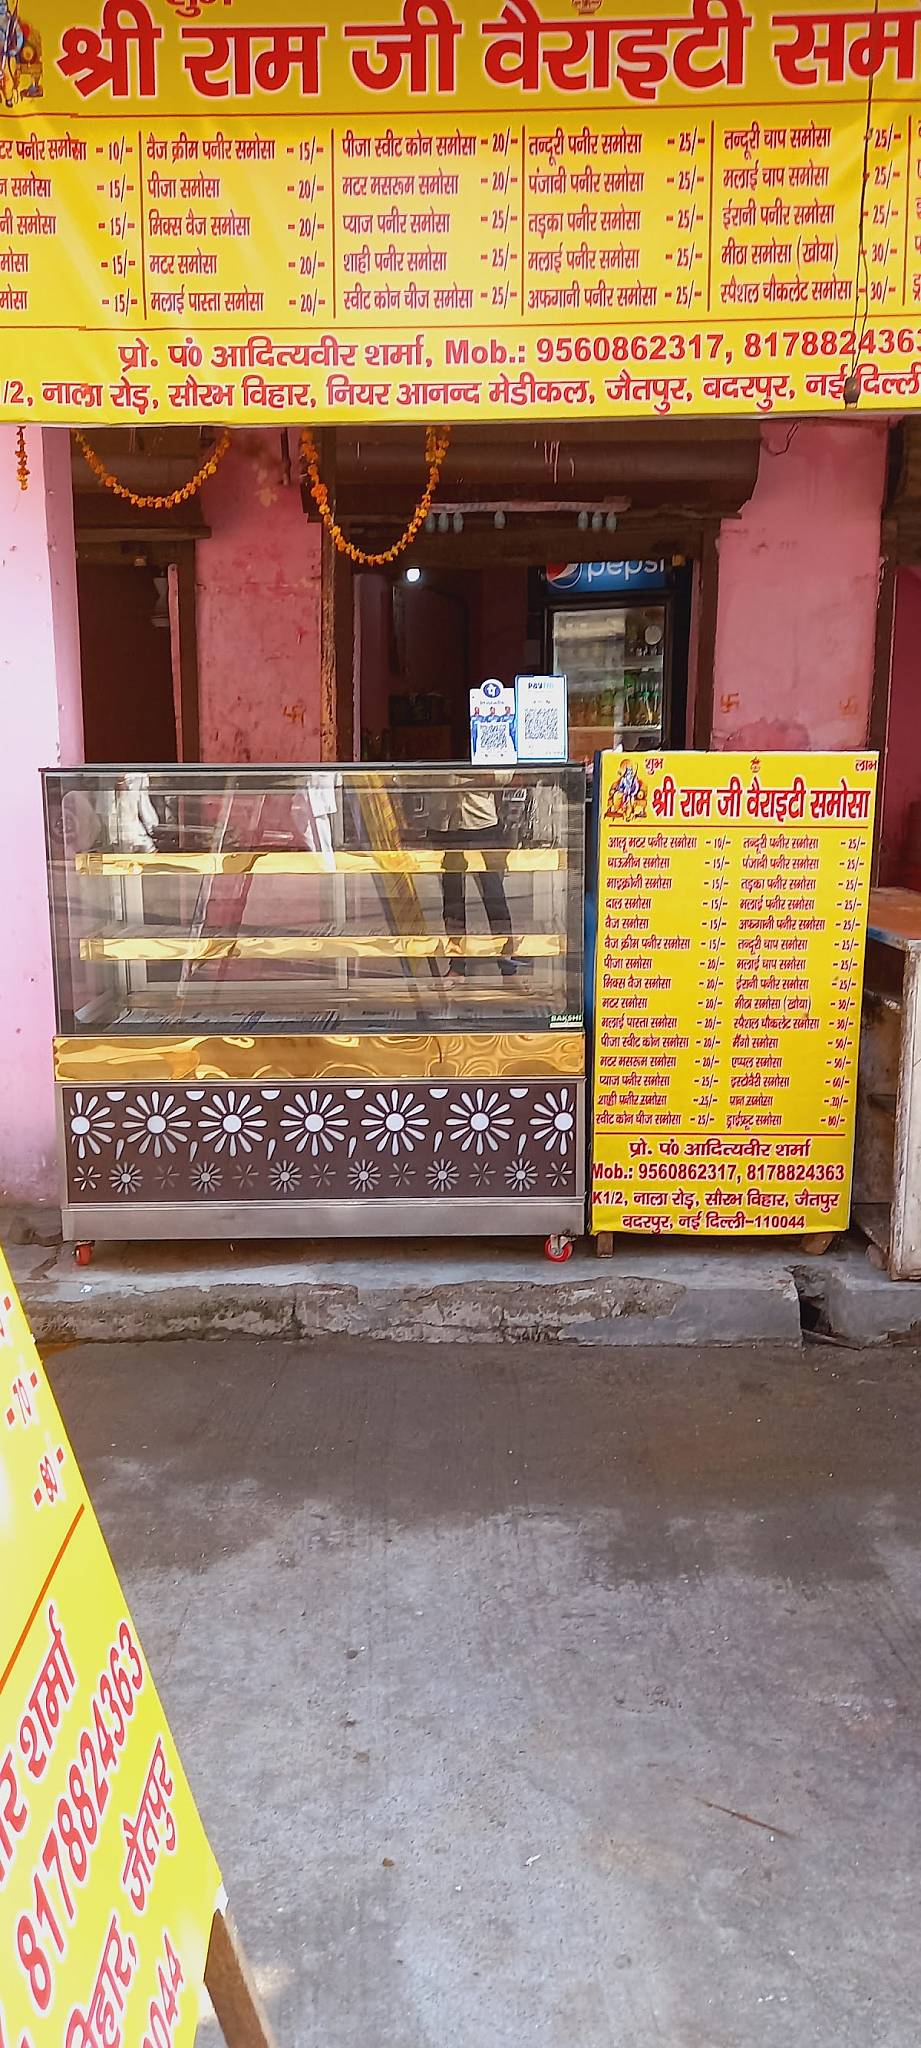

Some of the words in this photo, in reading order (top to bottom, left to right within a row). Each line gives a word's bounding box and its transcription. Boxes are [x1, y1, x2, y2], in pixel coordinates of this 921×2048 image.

[57, 0, 162, 98] श्री
[182, 25, 326, 98] राम
[344, 0, 462, 95] जी
[481, 0, 752, 99] वैराइटी
[16, 132, 45, 160] पनीर
[47, 132, 87, 160] समोसा
[146, 132, 168, 160] वैज
[171, 132, 199, 163] क्रीम
[202, 132, 233, 160] पनीर
[235, 132, 275, 160] समोसा
[342, 130, 371, 157] पीजा
[374, 129, 403, 157] स्वीट
[405, 129, 433, 156] कोन
[436, 128, 477, 156] समोसा
[529, 127, 565, 166] तन्दूरी
[568, 126, 599, 155] पनीर
[601, 126, 642, 155] समोसा
[724, 121, 760, 160] तन्दूरी
[764, 129, 787, 149] चाप
[790, 120, 831, 148] समोसा
[11, 170, 51, 197] समोसा
[147, 170, 176, 198] पीजा
[180, 170, 220, 198] समोसा
[343, 177, 368, 196] मटर
[370, 176, 415, 195] मसरूम
[418, 167, 459, 195] समोसा
[570, 165, 601, 192] पनीर
[604, 165, 644, 192] समोसा
[723, 160, 759, 191] मलाई
[762, 168, 785, 187] चाप
[789, 159, 829, 187] समोसा
[16, 208, 56, 235] समोसा
[148, 209, 182, 236] मिक्स
[186, 208, 207, 236] वैज
[210, 209, 250, 236] समोसा
[343, 215, 373, 234] प्याज
[377, 206, 407, 233] पनीर
[410, 206, 450, 233] समोसा
[528, 213, 563, 239] तड़का
[567, 204, 598, 231] पनीर
[600, 203, 641, 231] समोसा
[723, 198, 757, 230] ईरानी
[760, 197, 791, 226] पनीर
[794, 198, 835, 225] समोसा
[149, 255, 175, 274] मटर
[178, 247, 217, 274] समोसा
[344, 245, 370, 274] शाही
[374, 244, 404, 271] पनीर
[407, 245, 447, 271] समोसा
[528, 242, 563, 273] मलाई
[566, 242, 596, 269] पनीर
[599, 242, 640, 269] समोसा
[722, 237, 748, 265] मीठा
[751, 237, 792, 264] समोसा
[797, 235, 838, 269] (खोया)
[150, 284, 185, 314] मलाई
[188, 293, 221, 311] पास्ता
[224, 285, 264, 311] समोसा
[344, 282, 371, 309] स्वीट
[374, 283, 401, 309] कोन
[404, 282, 429, 309] चीज
[434, 282, 473, 309] समोसा
[528, 280, 580, 309] अफगानी
[584, 280, 614, 307] पनीर
[617, 280, 657, 307] समोसा
[812, 273, 852, 301] समोसा
[118, 338, 158, 372] प्रो.
[211, 335, 358, 367] आदित्यवीर
[365, 335, 432, 367] शर्मा,
[446, 339, 525, 364] Mob.:
[537, 334, 732, 364] 9560862317,
[42, 383, 103, 407] नाला
[110, 376, 158, 415] रोड़,
[168, 374, 235, 407] सौरभ
[241, 375, 316, 408] विहार,
[326, 374, 391, 405] नियर
[396, 383, 482, 405] आनन्द
[489, 372, 595, 405] मेडीकल,
[603, 369, 696, 418] जैतपुर,
[701, 376, 798, 415] बदरपुर,
[806, 364, 848, 402] नई
[645, 758, 663, 775] शुभ
[855, 760, 877, 771] लाभ
[652, 776, 676, 816] श्री
[680, 789, 712, 817] राम
[717, 776, 743, 817] जी
[747, 776, 806, 822] वैराइटी
[810, 778, 871, 818] समोसा
[608, 837, 628, 853] आलू
[628, 837, 646, 848] मटर
[648, 833, 668, 848] पनीर
[670, 836, 697, 848] समोसा
[643, 854, 670, 868] समोसा
[606, 898, 623, 909] दाल
[624, 895, 651, 909] समोसा
[605, 914, 620, 928] वैज
[622, 914, 649, 929] समोसा
[604, 954, 623, 969] पीजा
[625, 955, 652, 969] समोसा
[602, 998, 619, 1008] मटर
[621, 994, 647, 1008] समोसा
[752, 1034, 778, 1048] समोसा
[629, 1138, 652, 1158] प्रो.
[684, 1138, 772, 1156] आदित्यवीर
[775, 1139, 811, 1156] शर्मा
[592, 1163, 633, 1181] Mob.:
[639, 1163, 741, 1184] 9560862317,
[747, 1164, 844, 1180] 8178824363
[634, 1192, 668, 1206] नाला
[672, 1188, 699, 1210] रोड़,
[705, 1187, 745, 1209] सौरभ
[747, 1188, 789, 1207] विहार,
[794, 1188, 840, 1213] जैतपुर
[679, 1211, 703, 1230] नई
[19, 1604, 75, 1779] शर्मा
[17, 1621, 143, 2011] 8178824363
[121, 1737, 178, 1912] जैतपुर
